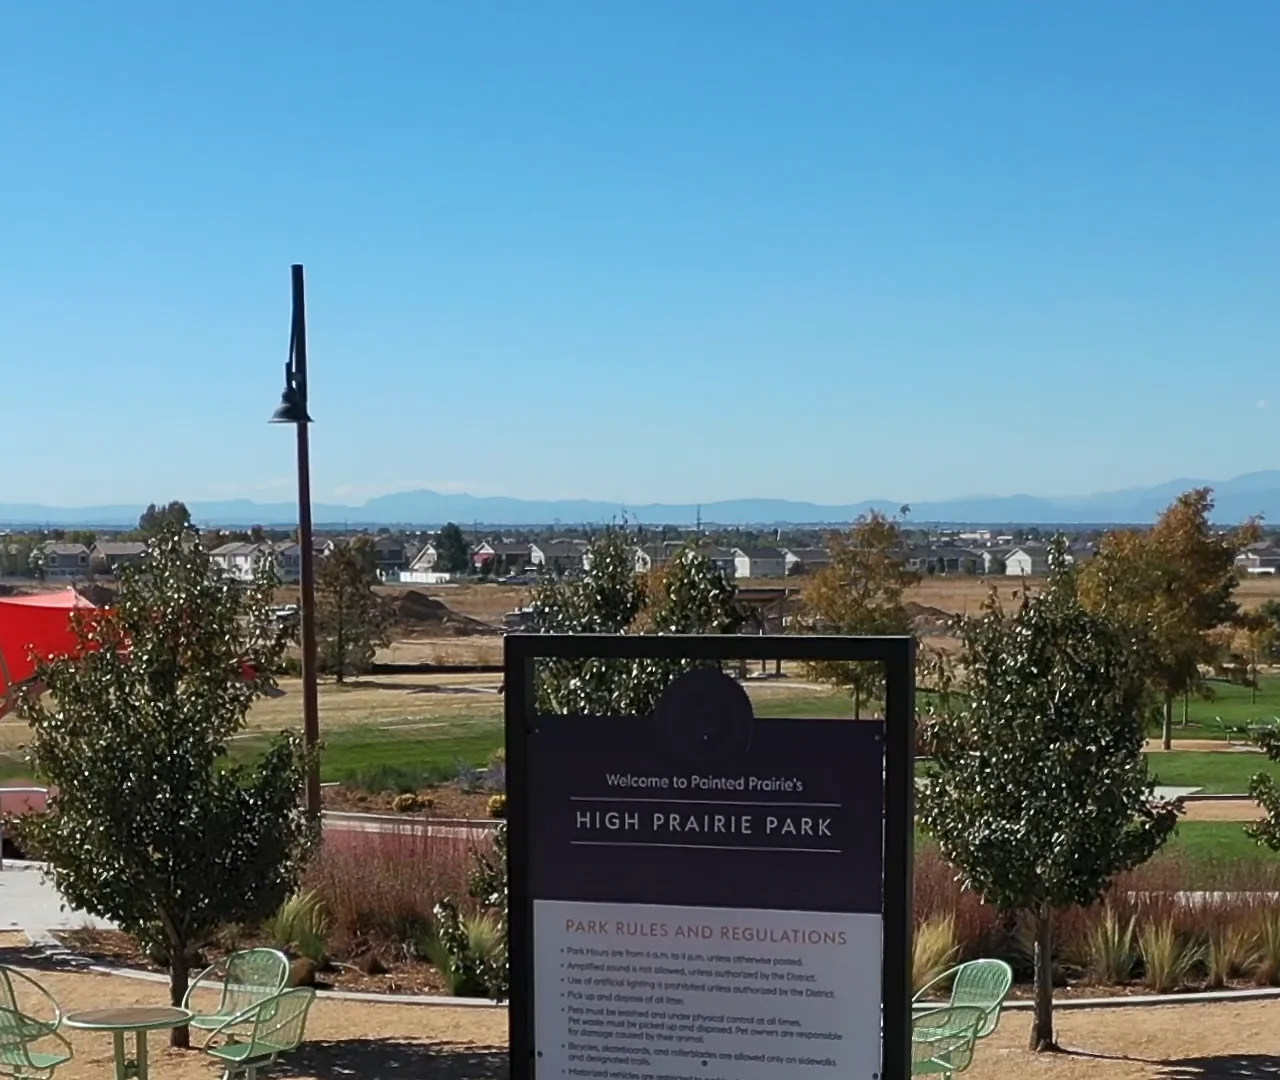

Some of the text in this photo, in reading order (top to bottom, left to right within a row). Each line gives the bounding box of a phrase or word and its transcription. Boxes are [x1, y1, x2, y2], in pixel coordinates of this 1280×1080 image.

[606, 773, 803, 792] Welcome to Painted Prairie's
[576, 811, 832, 837] HIGH PRAIRIE PARK
[565, 919, 848, 946] PARK RULES AND REGULATIONS
